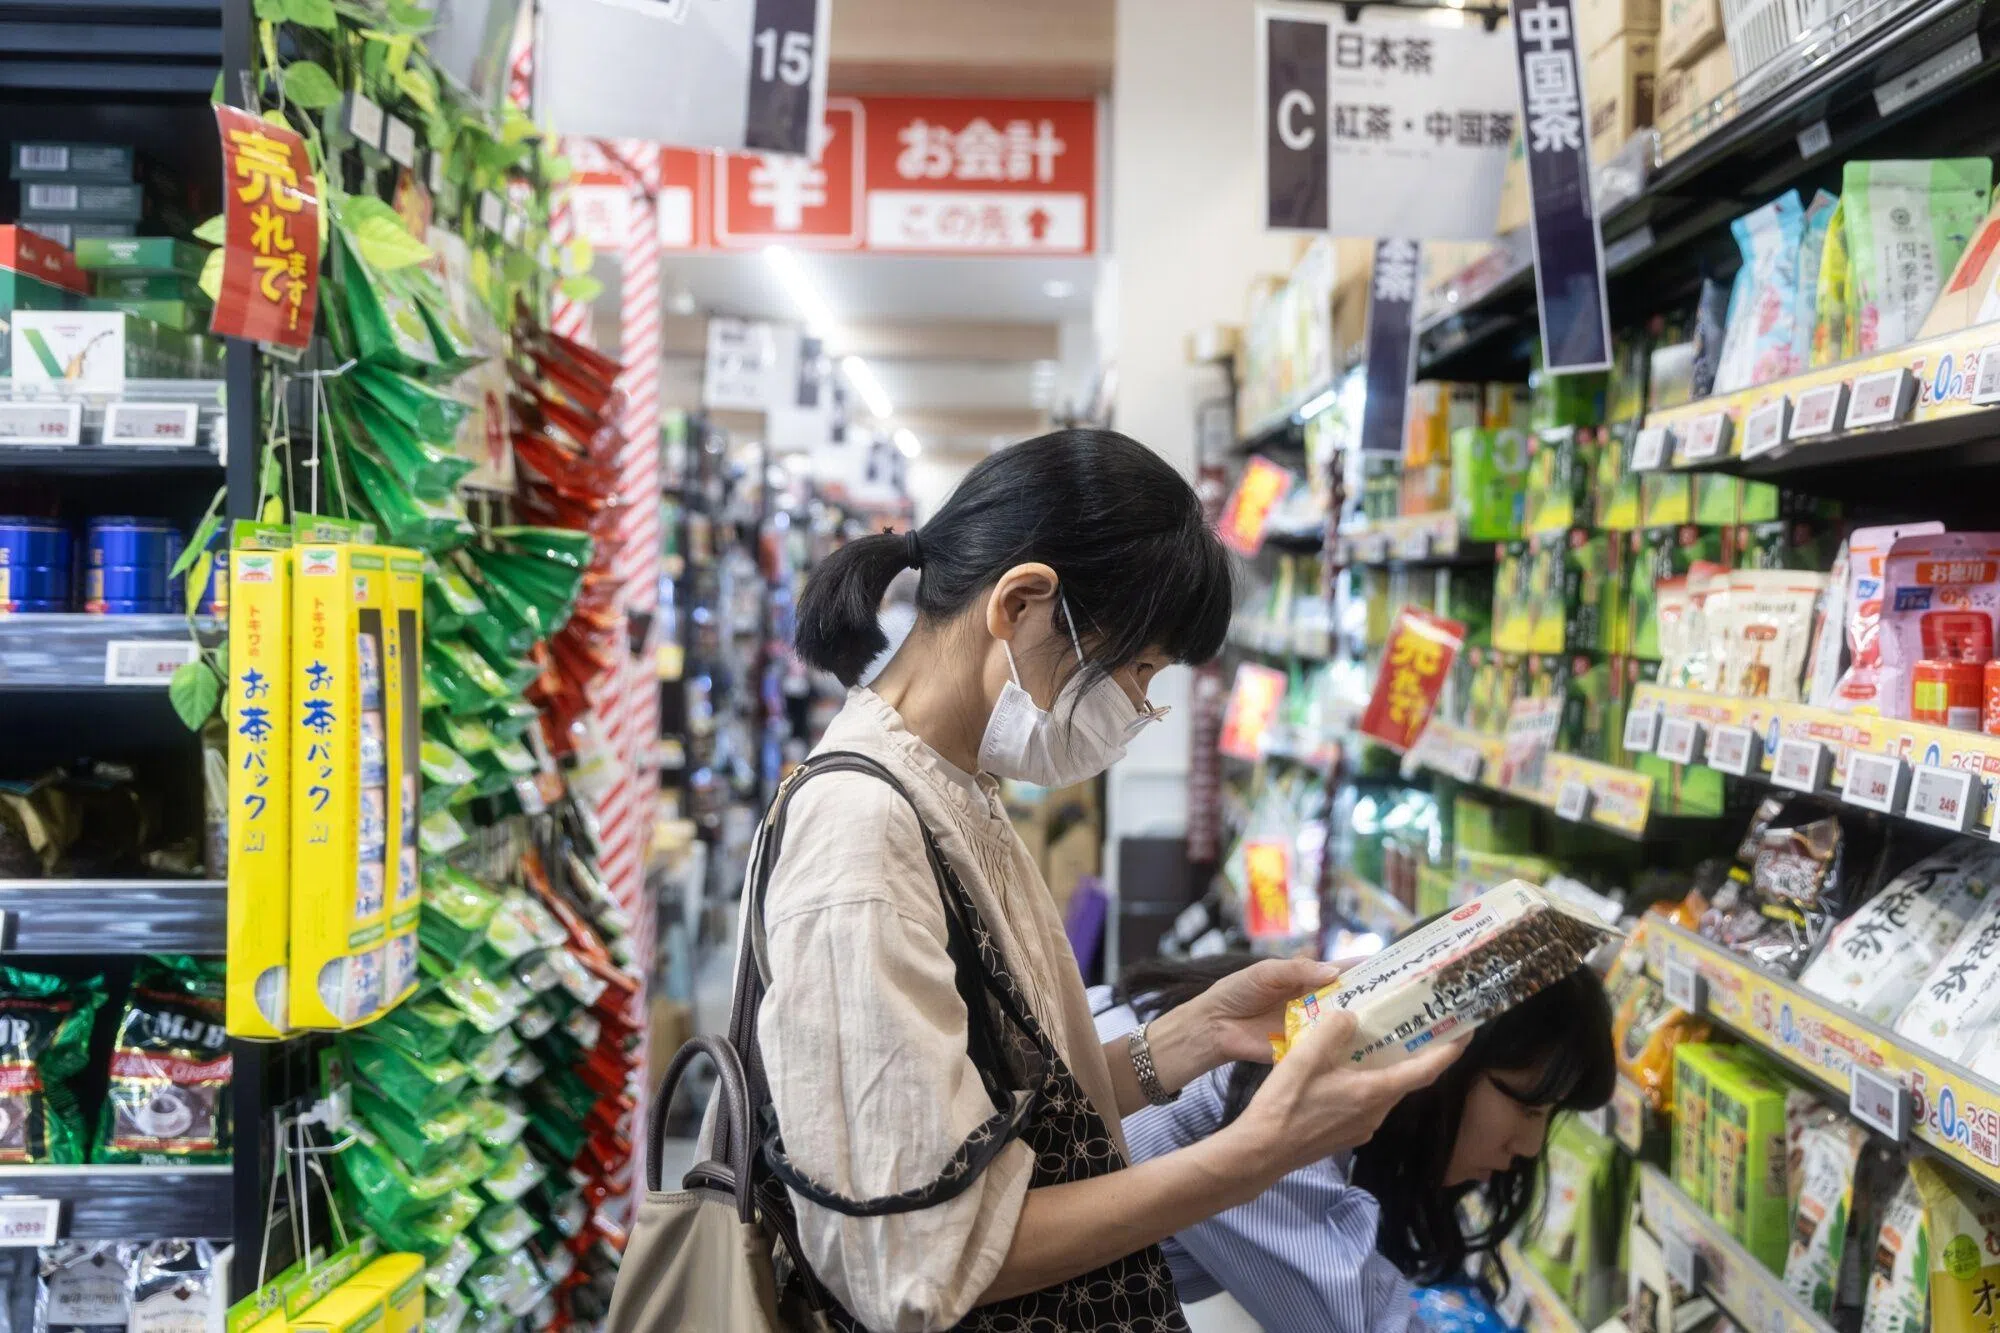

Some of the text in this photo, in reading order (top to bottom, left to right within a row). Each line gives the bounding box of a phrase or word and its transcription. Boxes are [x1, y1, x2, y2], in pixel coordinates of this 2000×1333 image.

[755, 28, 812, 86] 15
[1336, 33, 1433, 75] 日本茶
[1520, 1, 1582, 152] 中国茶
[1277, 89, 1316, 150] C
[1335, 104, 1514, 147] 紅茶・中国茶
[896, 117, 1066, 184] お会計
[239, 667, 273, 820] お茶パック
[302, 659, 337, 812] お茶パック
[1939, 797, 1957, 813] 249
[153, 1011, 228, 1049] MJB
[1966, 1106, 1998, 1137] つく日
